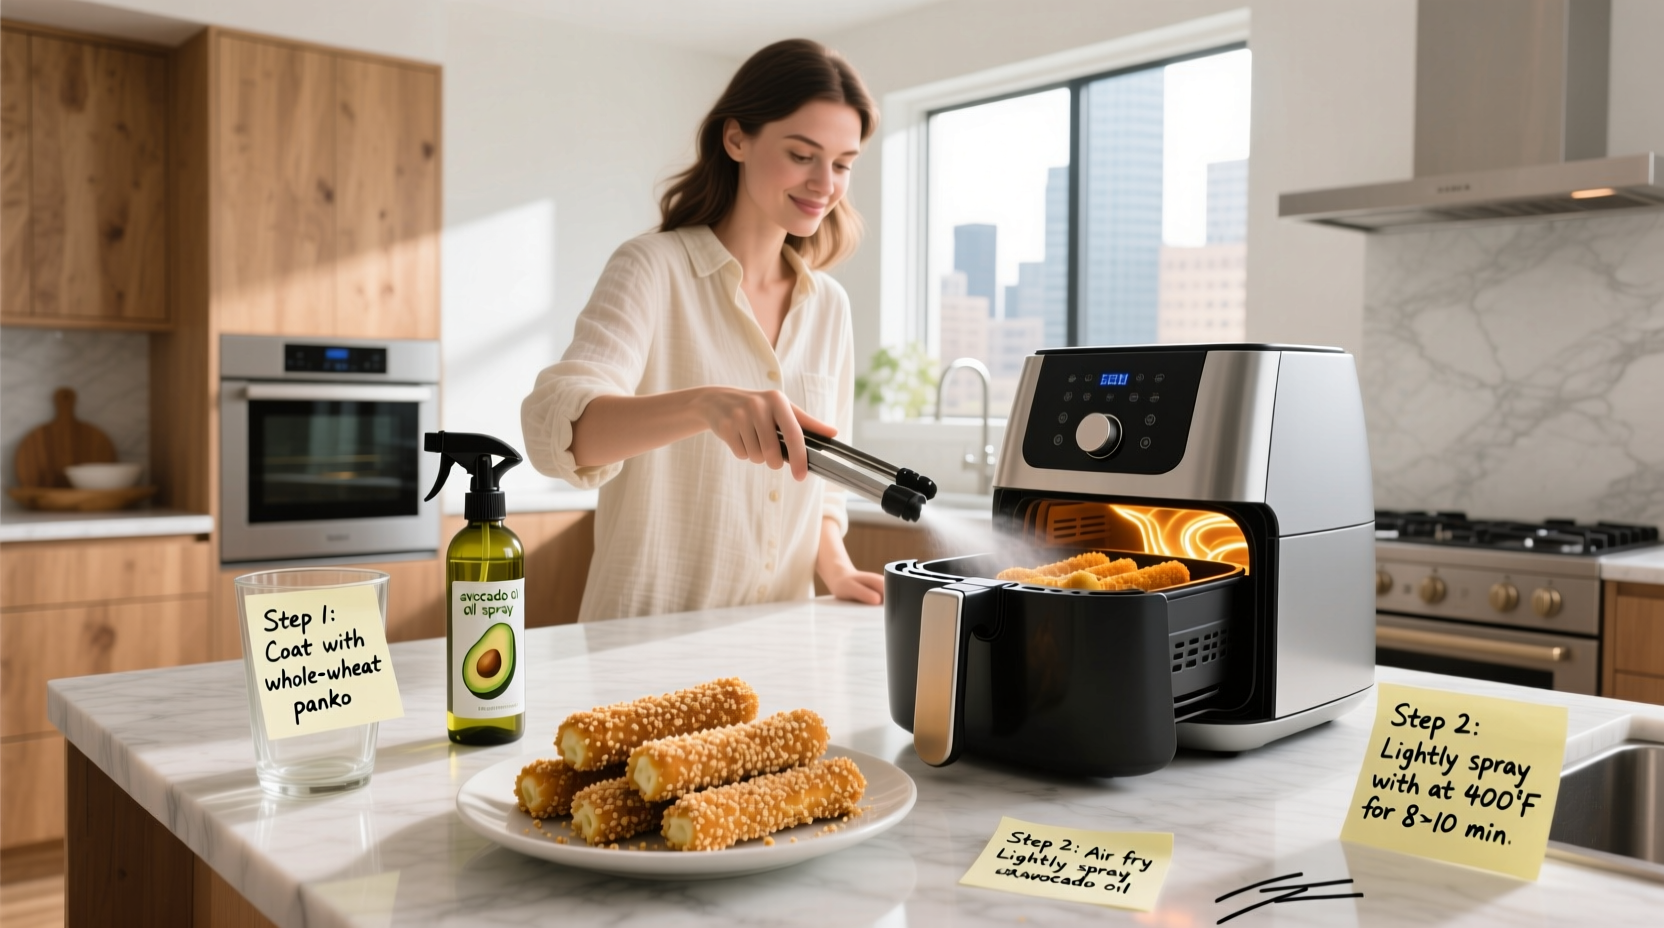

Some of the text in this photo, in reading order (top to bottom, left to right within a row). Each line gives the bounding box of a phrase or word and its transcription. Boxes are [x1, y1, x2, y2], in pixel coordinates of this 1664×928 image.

[460, 589, 509, 602] avocado
[482, 604, 514, 619] spray
[263, 604, 336, 635] Step 1:
[265, 628, 365, 663] Coat with
[264, 654, 382, 692] whole-wheat
[293, 688, 352, 726] panko
[1390, 702, 1480, 740] Step 2:
[1380, 736, 1531, 789] Lightly spray
[1372, 772, 1420, 795] with
[1427, 780, 1455, 800] at
[1361, 795, 1396, 820] for
[1464, 822, 1512, 846] min.
[996, 847, 1132, 884] Lightly spray
[1006, 831, 1153, 873] Step 2: Air fry
[1104, 883, 1131, 894] oil
